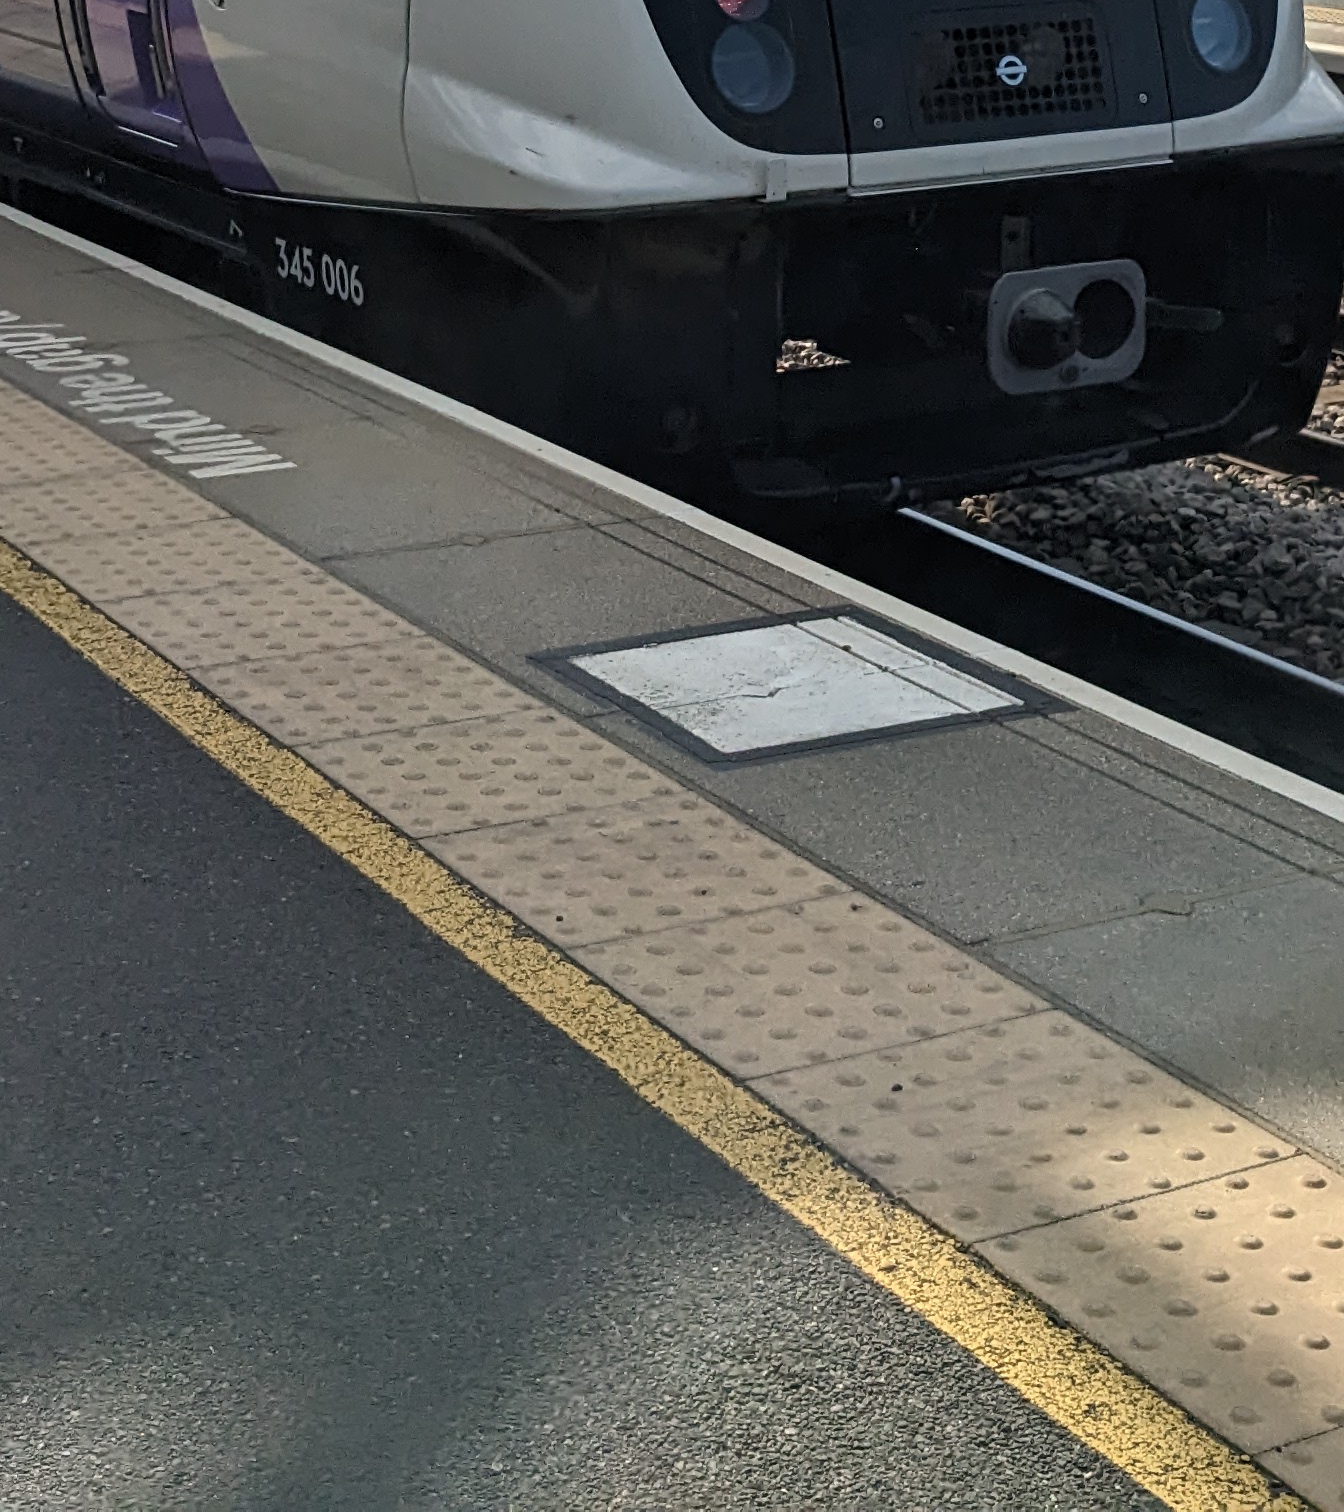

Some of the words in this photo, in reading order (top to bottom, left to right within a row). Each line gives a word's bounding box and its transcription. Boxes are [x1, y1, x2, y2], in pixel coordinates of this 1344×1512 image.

[274, 237, 315, 287] 345
[321, 253, 364, 306] 006
[58, 372, 175, 413] the
[98, 409, 298, 479] Mind
